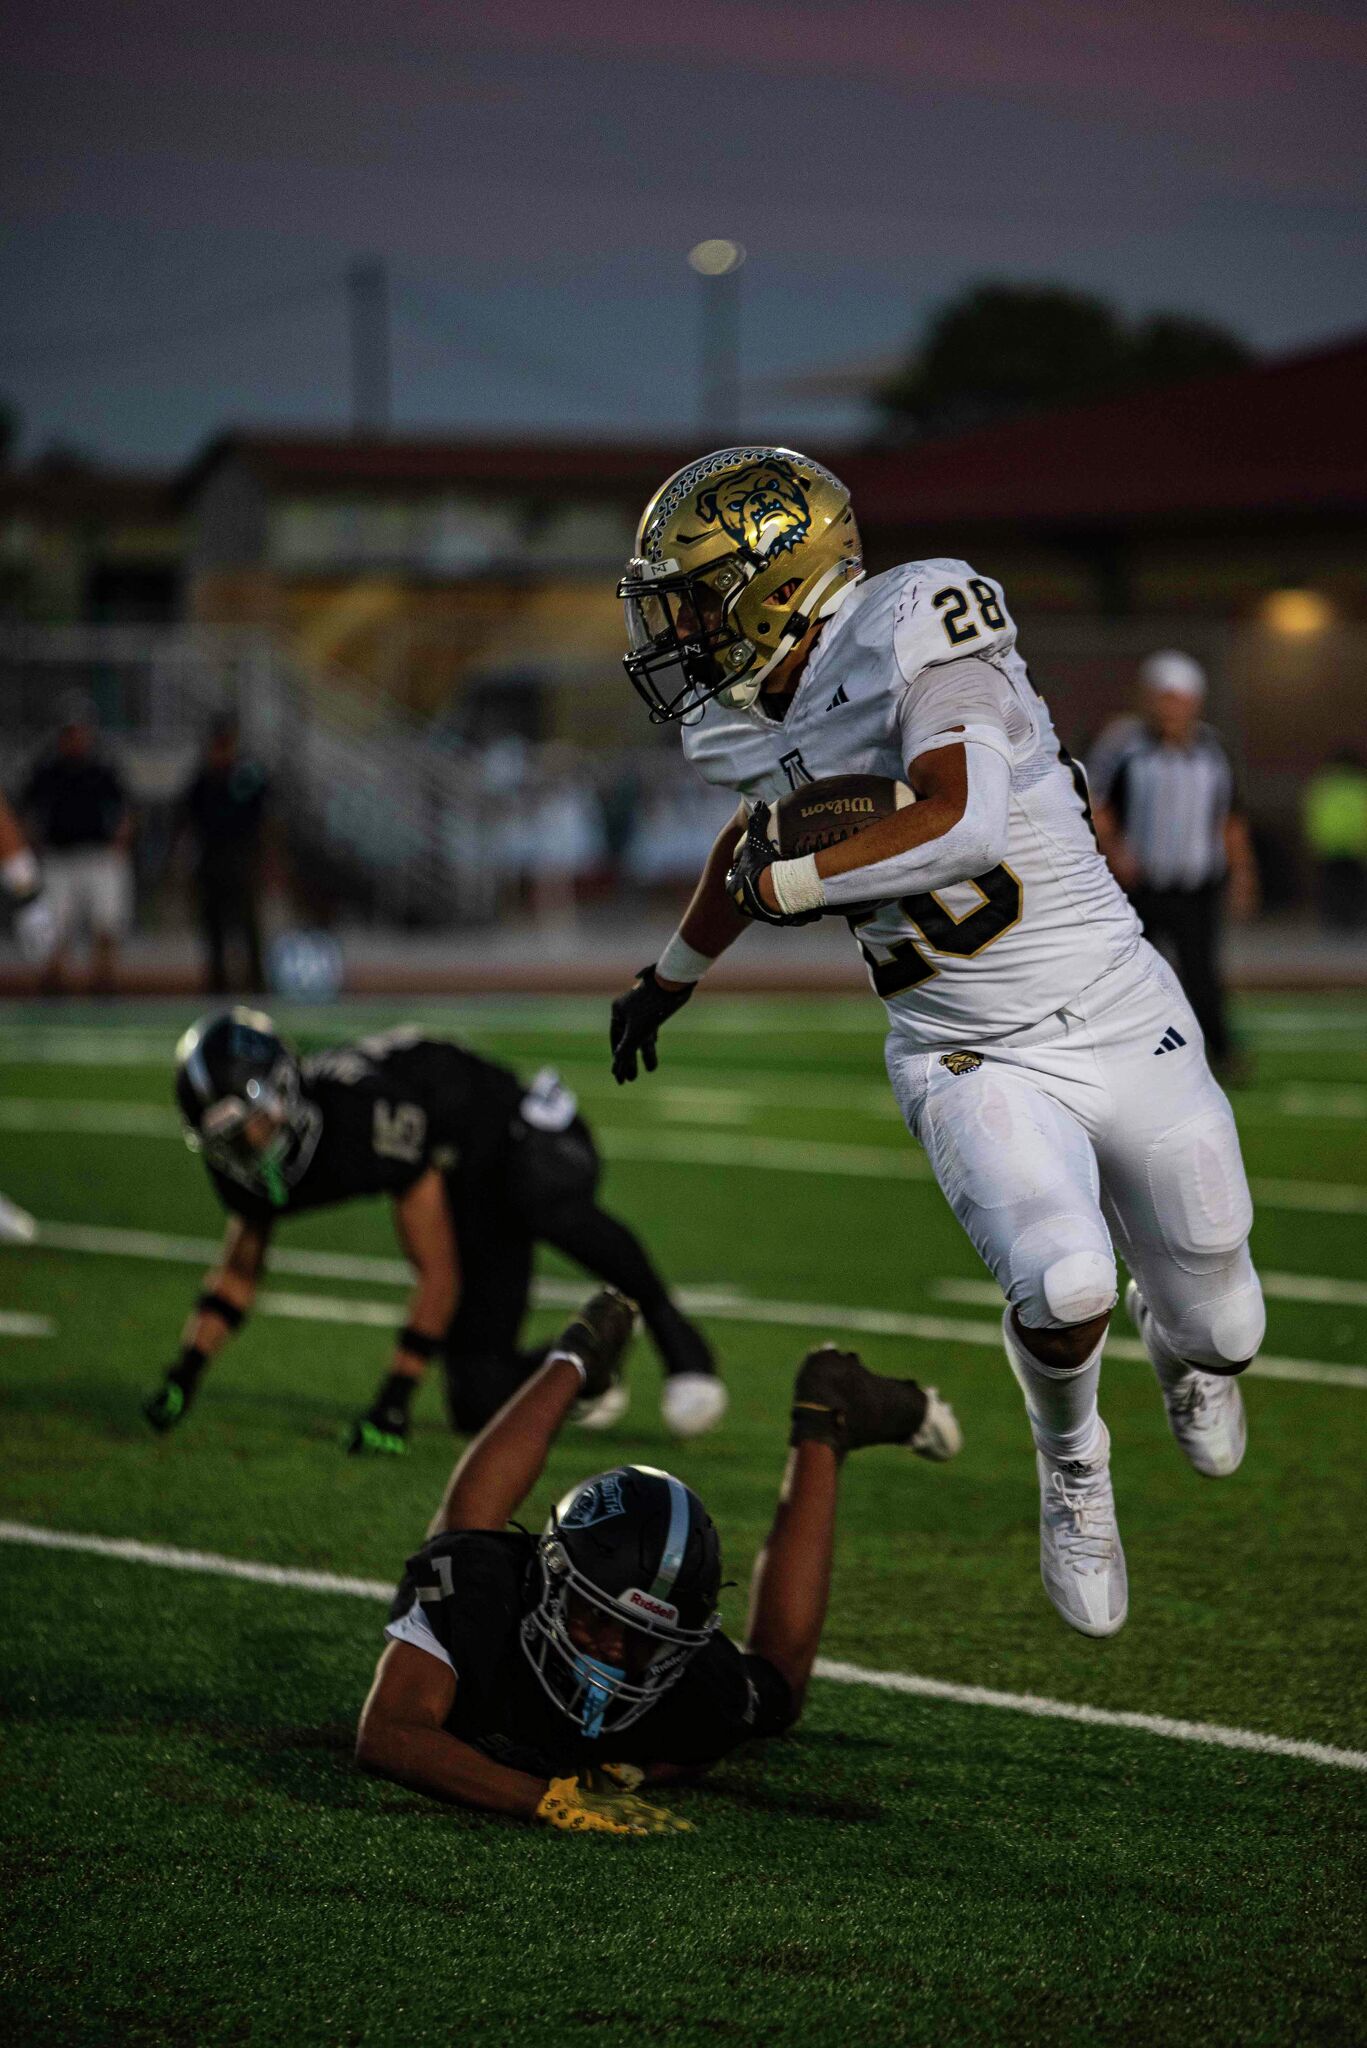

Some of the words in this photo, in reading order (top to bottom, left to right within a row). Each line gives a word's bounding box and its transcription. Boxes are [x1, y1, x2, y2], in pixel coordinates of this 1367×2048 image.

[931, 578, 1007, 648] 28
[801, 797, 875, 818] Wilson
[630, 1592, 676, 1620] Riddell
